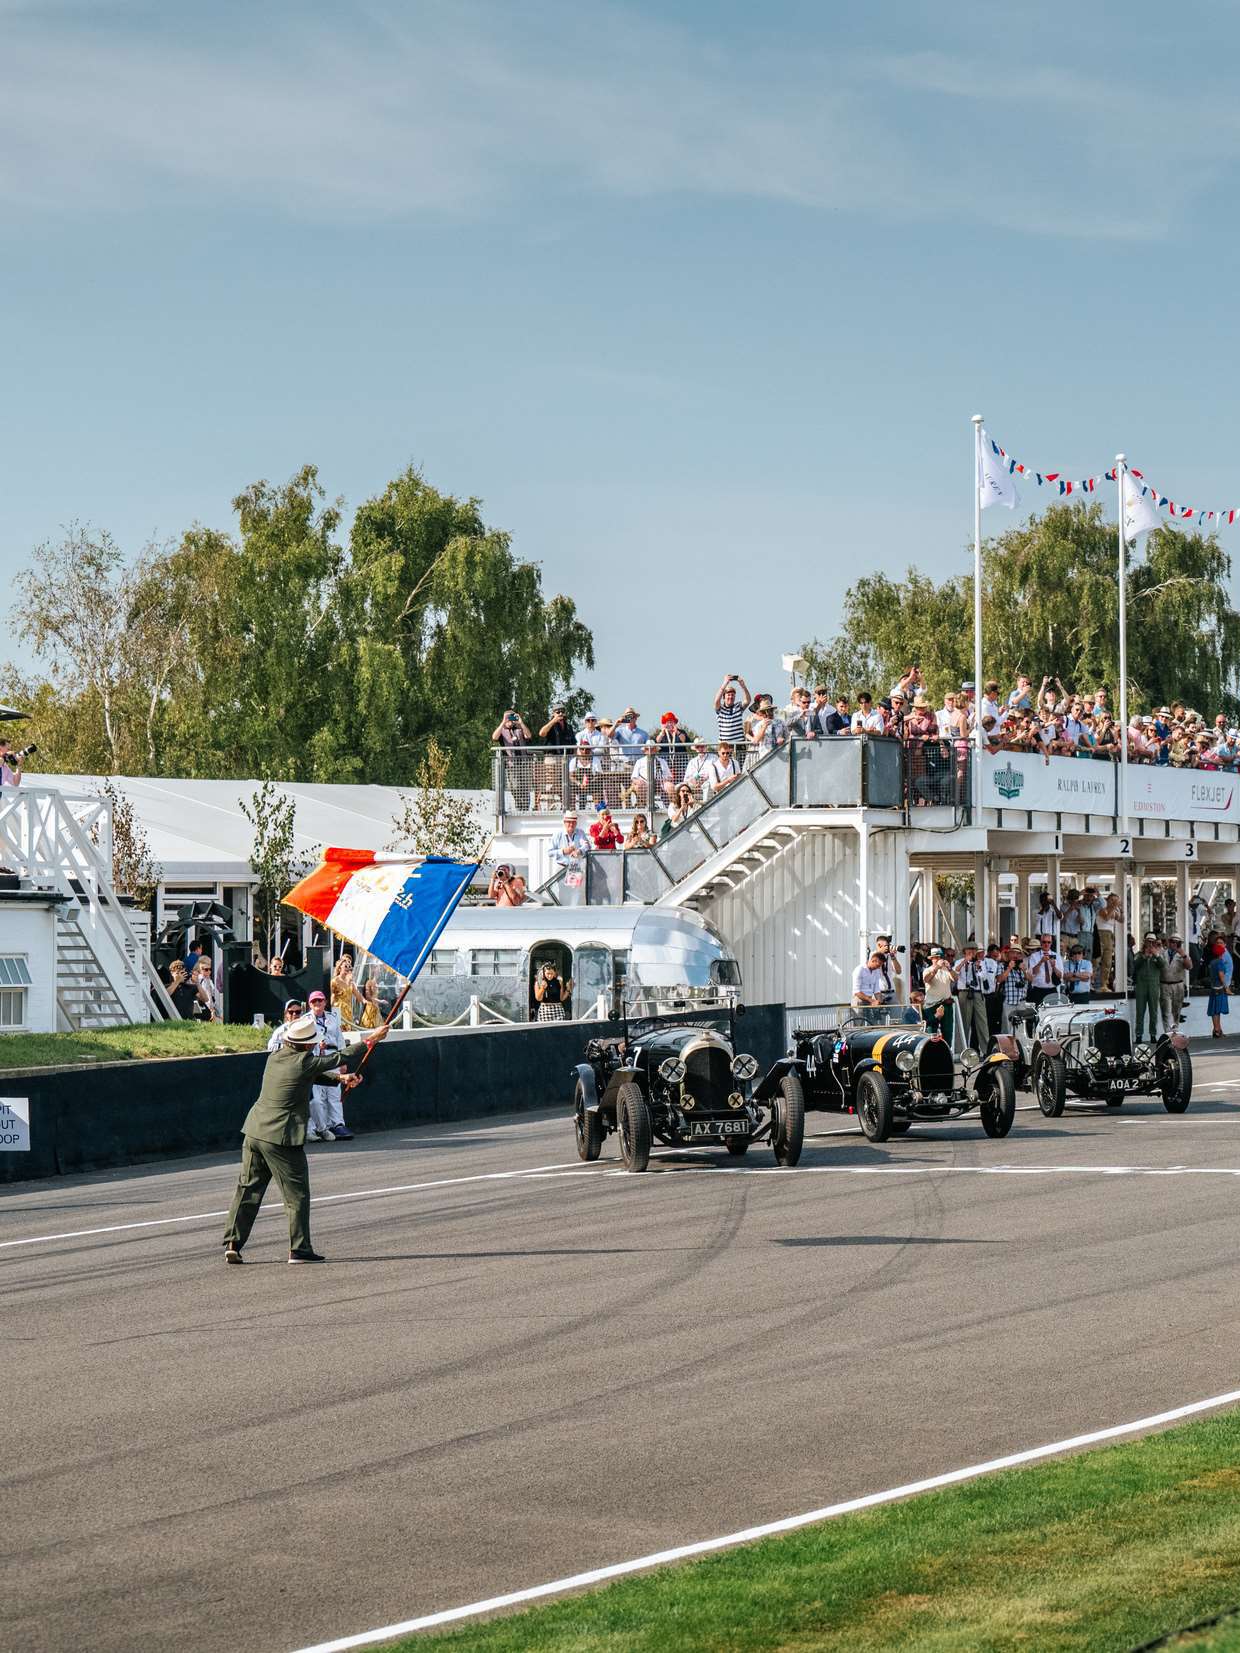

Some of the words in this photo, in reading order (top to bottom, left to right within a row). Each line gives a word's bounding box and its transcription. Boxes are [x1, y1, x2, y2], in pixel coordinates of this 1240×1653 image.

[1057, 778, 1079, 793] RALPH
[1081, 779, 1106, 794] LAUREN
[1121, 840, 1129, 853] 2
[1186, 843, 1193, 856] 3
[892, 1034, 916, 1047] 44
[633, 1046, 642, 1068] 7
[806, 1054, 817, 1078] 44
[1110, 1079, 1130, 1089] AOA
[1132, 1079, 1139, 1088] 2
[0, 1105, 12, 1115] IT
[0, 1119, 16, 1130] UT
[695, 1123, 711, 1135] AX
[715, 1122, 746, 1134] 7681
